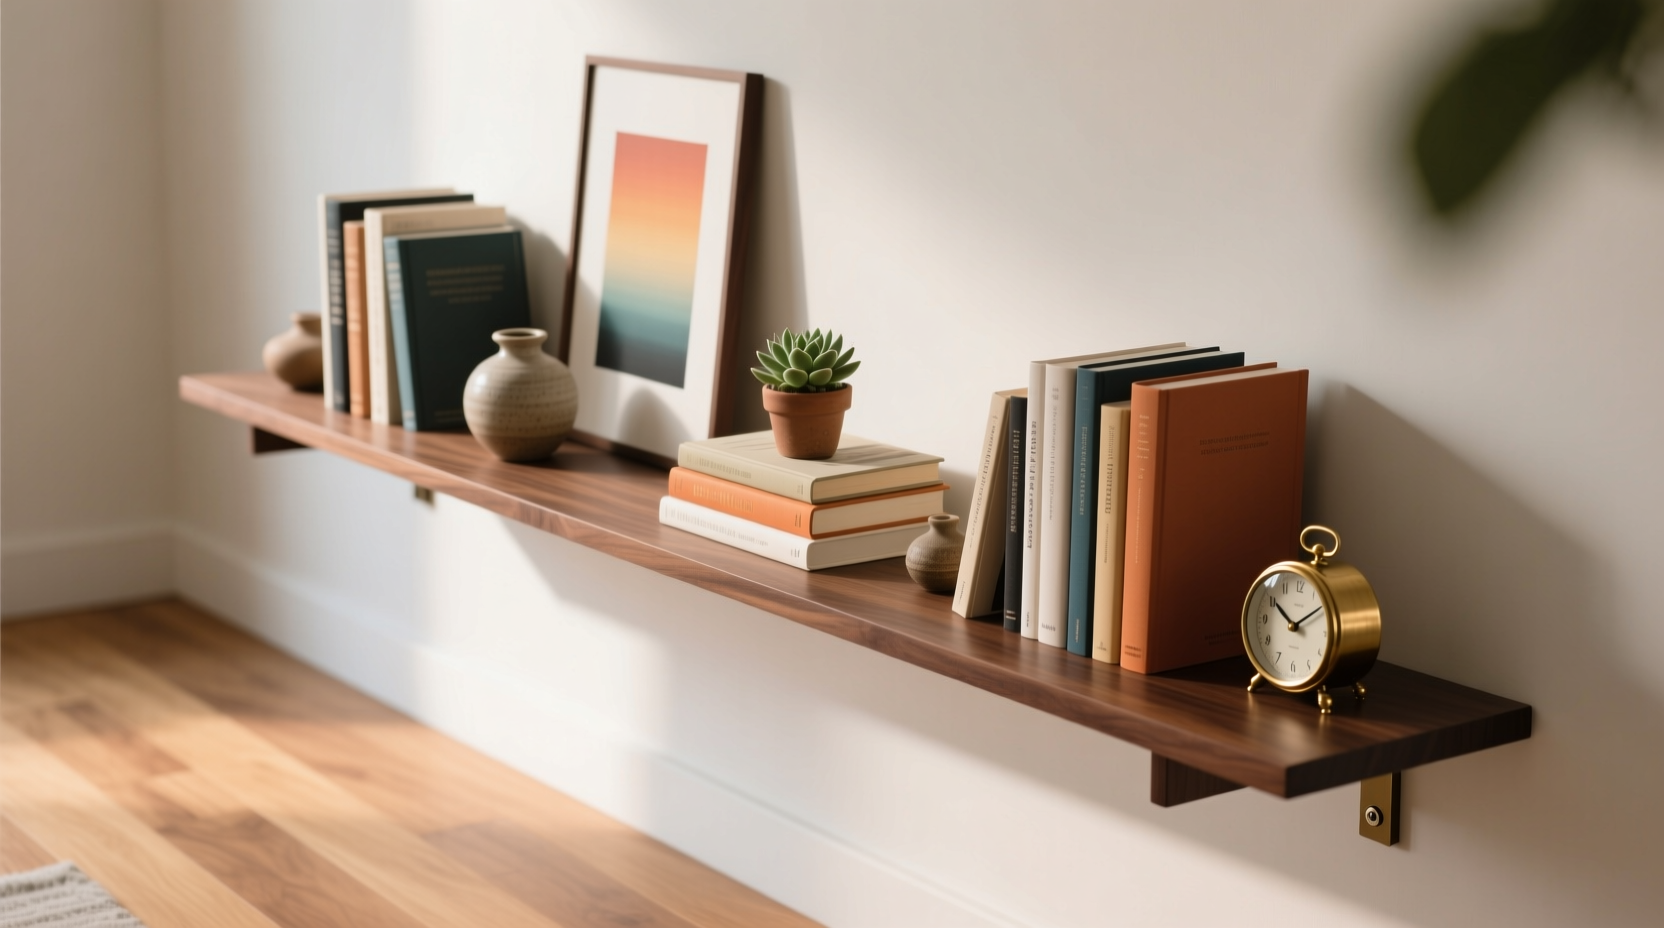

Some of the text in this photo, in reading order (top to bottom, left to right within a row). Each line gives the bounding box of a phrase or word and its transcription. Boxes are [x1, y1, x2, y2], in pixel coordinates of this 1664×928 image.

[1283, 582, 1289, 594] 11
[1297, 580, 1305, 593] 12
[1275, 652, 1282, 665] 7
